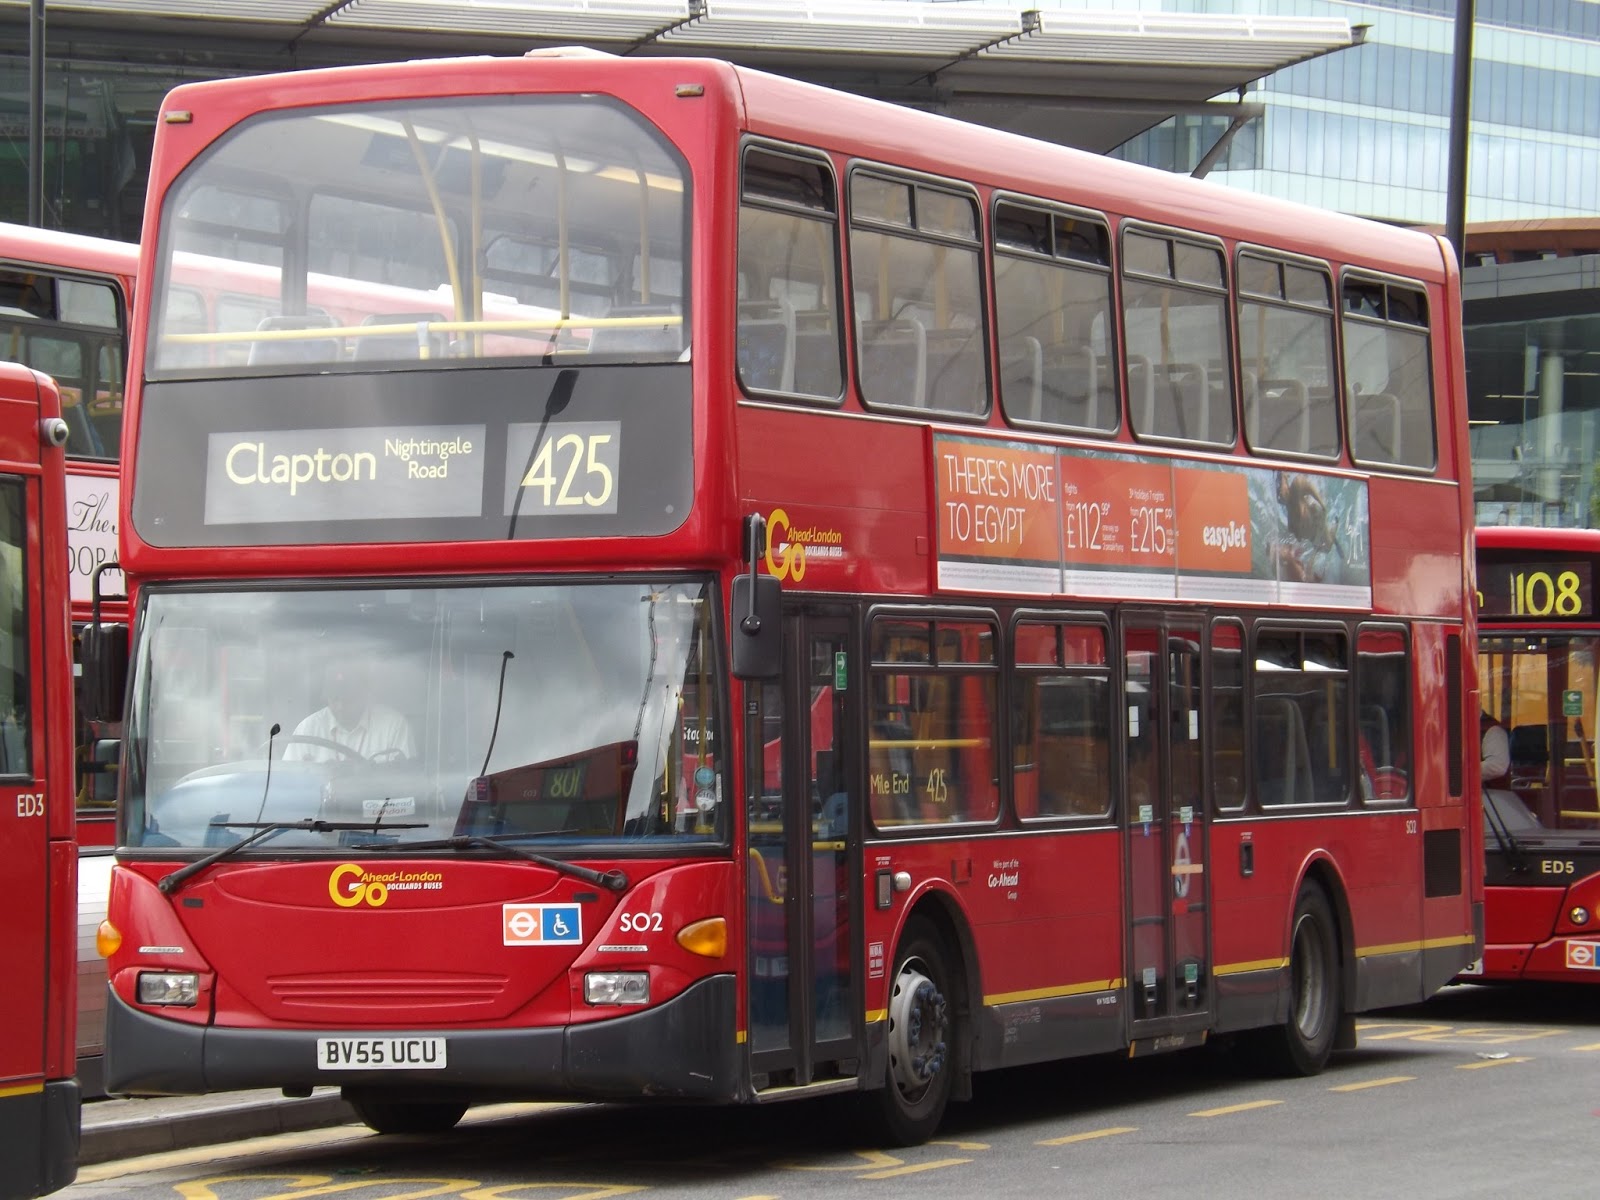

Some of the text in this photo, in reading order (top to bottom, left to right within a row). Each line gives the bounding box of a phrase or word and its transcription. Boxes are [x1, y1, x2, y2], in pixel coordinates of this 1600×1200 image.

[385, 436, 472, 460] Nightingale
[225, 442, 376, 496] Clapton
[408, 460, 448, 479] Road
[521, 433, 613, 507] 425
[944, 454, 1055, 502] THERE'S MORE
[68, 492, 109, 533] The
[946, 502, 1026, 545] TO EGYPT
[787, 526, 842, 544] Ahead-London
[1203, 521, 1247, 552] easyJet
[805, 546, 829, 557] DOCKLANDS
[1516, 571, 1582, 617] 108
[870, 773, 909, 795] Mile End
[926, 768, 948, 802] 425
[17, 793, 44, 818] ED3
[1541, 860, 1575, 874] ED5
[329, 863, 442, 907] Go Ahead-London
[386, 882, 443, 891] DOCKLANDS BUSES
[988, 872, 1019, 888] Go-Ahead
[326, 1040, 436, 1064] BV55 UCU
